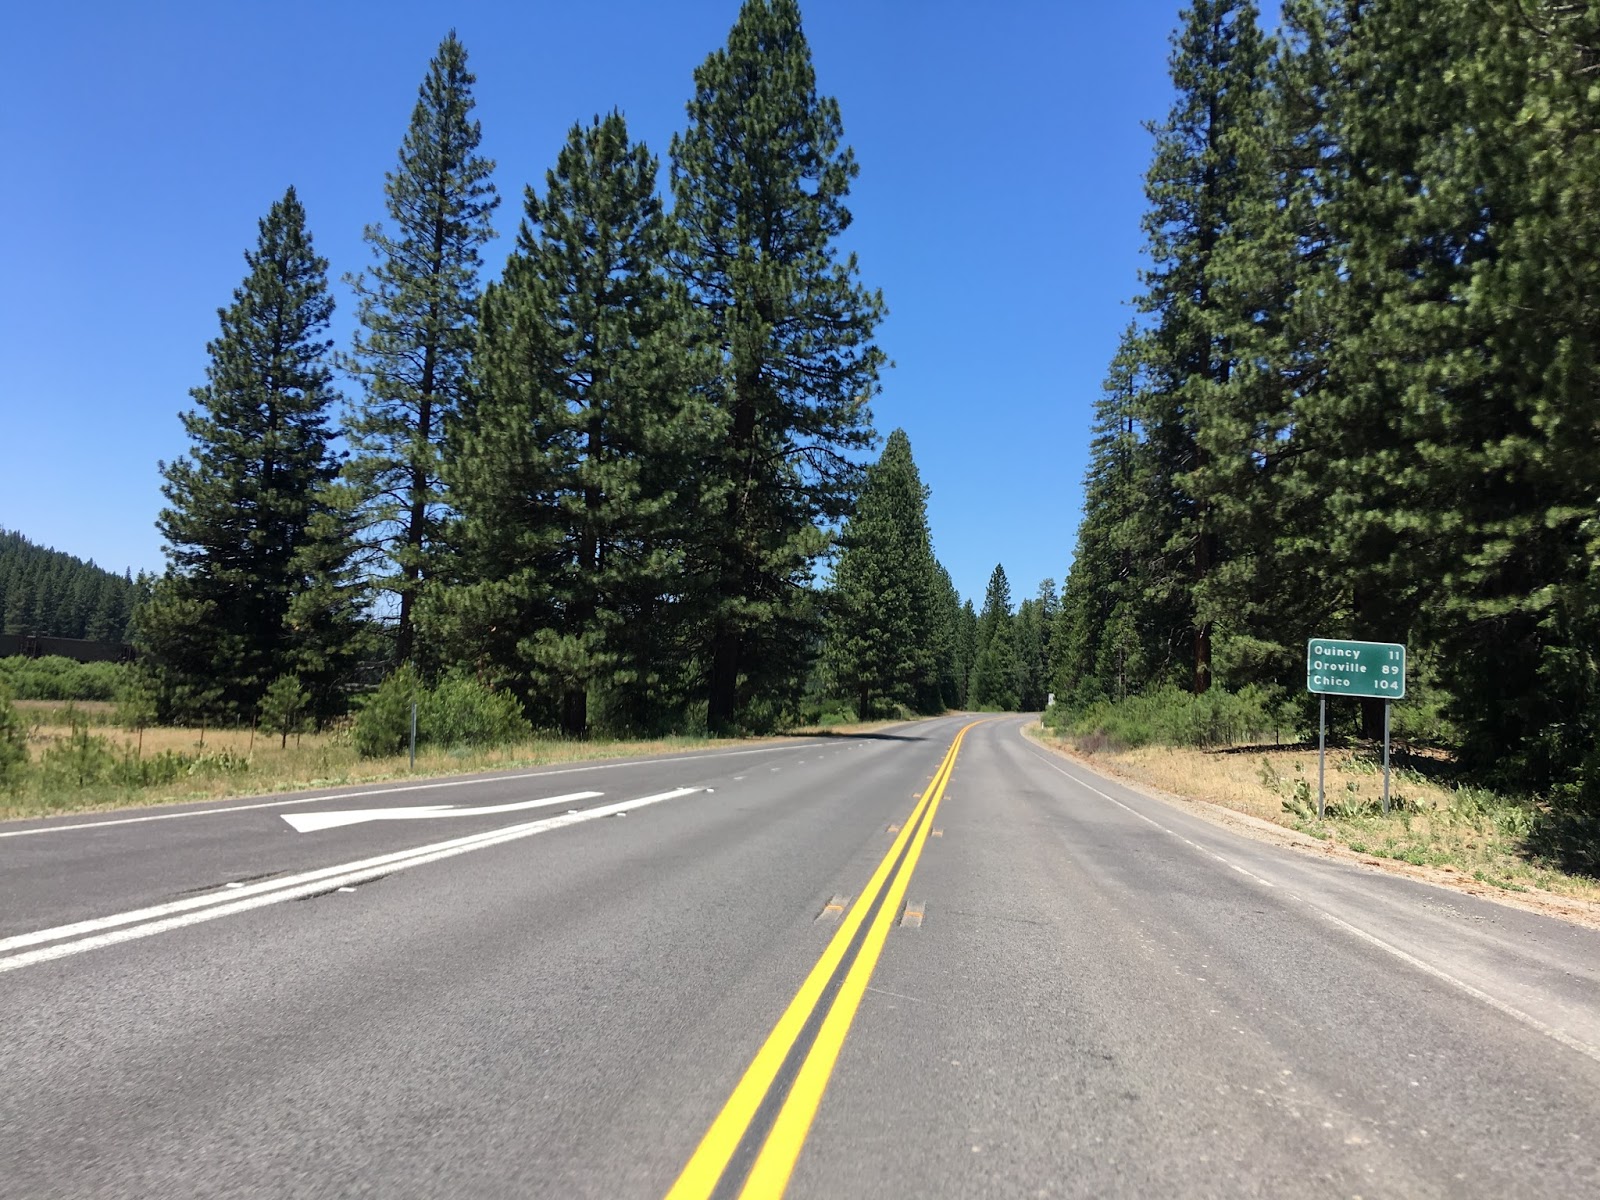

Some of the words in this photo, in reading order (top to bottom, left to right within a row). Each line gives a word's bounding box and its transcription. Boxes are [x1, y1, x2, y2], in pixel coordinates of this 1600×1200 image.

[1314, 645, 1360, 660] Quincy
[1389, 651, 1400, 660] 11
[1314, 660, 1367, 673] Oroville
[1381, 665, 1399, 675] 89
[1313, 675, 1350, 687] Chico
[1374, 680, 1399, 690] 104
